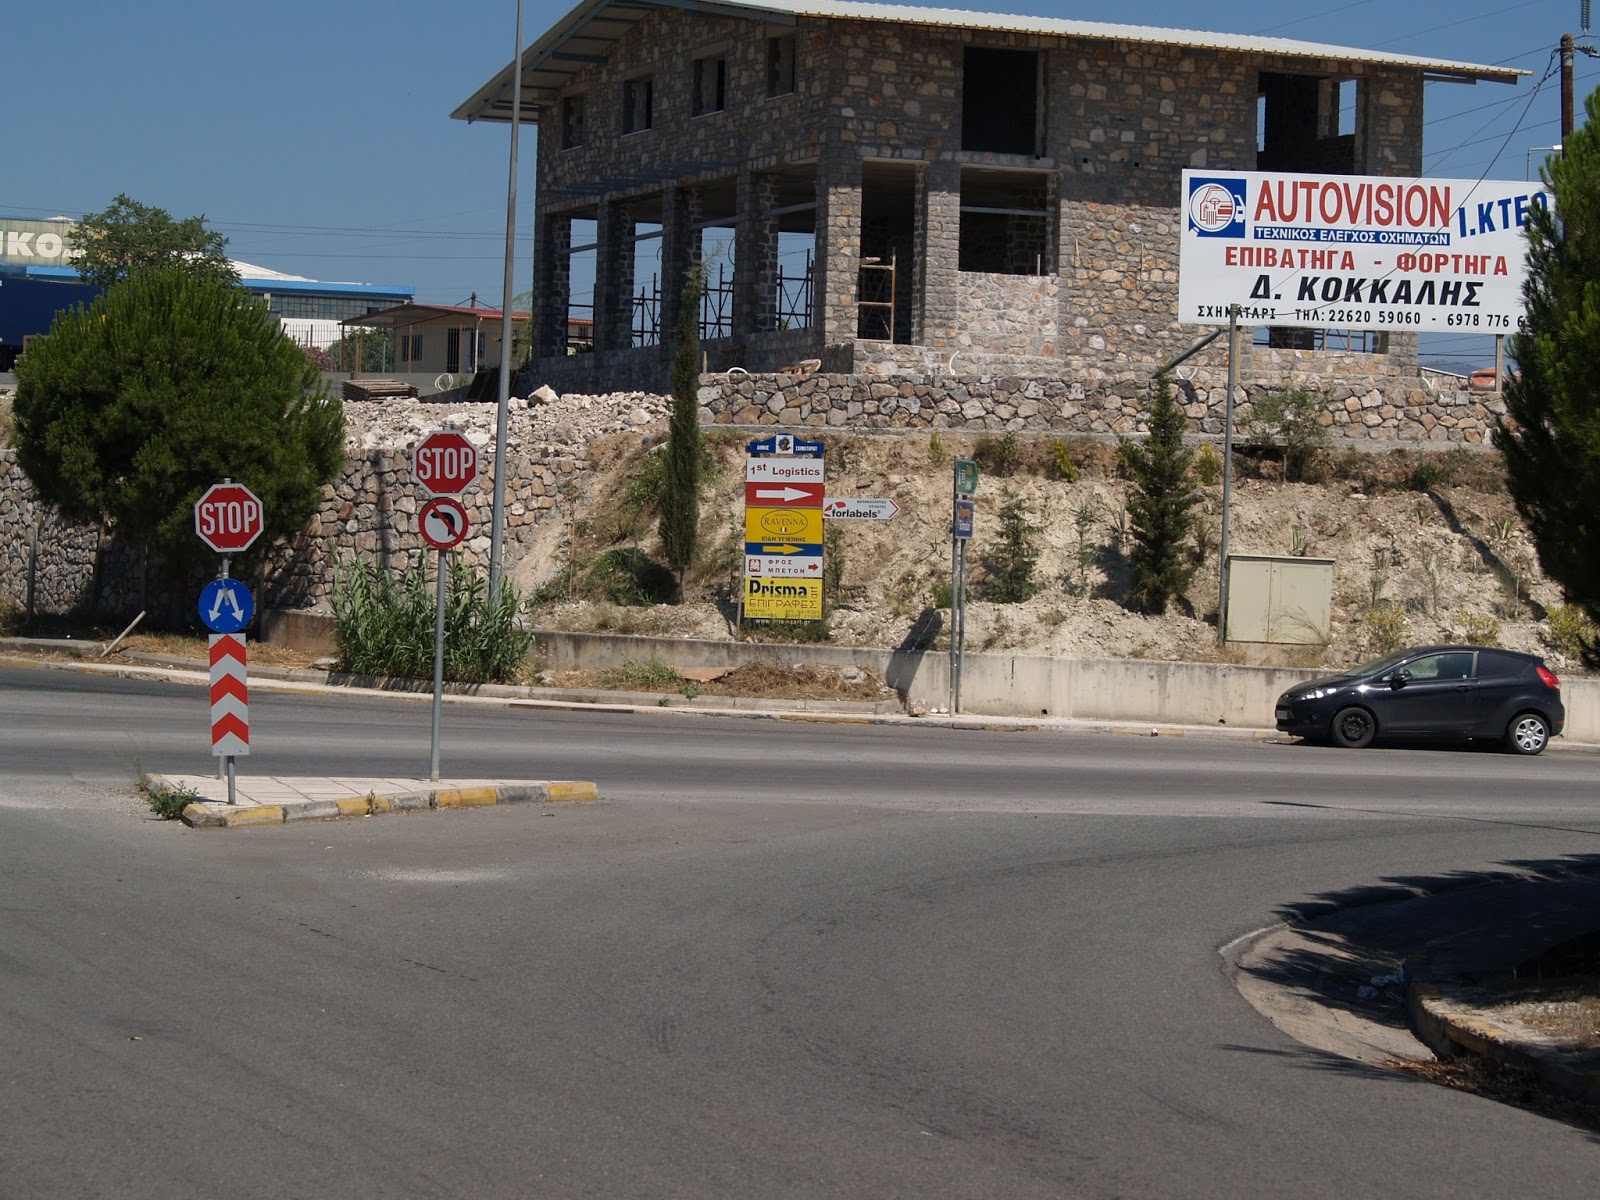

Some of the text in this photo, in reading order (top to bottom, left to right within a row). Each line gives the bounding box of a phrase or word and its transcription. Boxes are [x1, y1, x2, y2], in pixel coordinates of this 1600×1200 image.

[1254, 180, 1450, 228] AUTOVISION
[0, 231, 62, 258] KO
[1256, 227, 1447, 245] ΤΕΧΝΙΚΟΣ ΕΛΕΓΧΟΣ ΟΧΗΜΑΤΩΝ
[1225, 246, 1355, 271] ΕΠΙΒΑΤΗΓΑ
[1397, 252, 1508, 276] ΦΟΡΤΗΓΑ
[1250, 274, 1484, 307] Δ. ΚΟΚΚΑΛΗΣ
[1378, 312, 1421, 325] 59060
[1447, 313, 1480, 327] 6978
[1487, 314, 1510, 328] 776
[418, 447, 474, 480] STOP
[750, 463, 820, 477] 1st Logistics
[201, 501, 257, 536] STOP
[764, 517, 805, 526] RAVENNA
[750, 580, 807, 597] Prisma
[749, 599, 817, 609] ΕΠΙΓΡΑΦΕΣ
